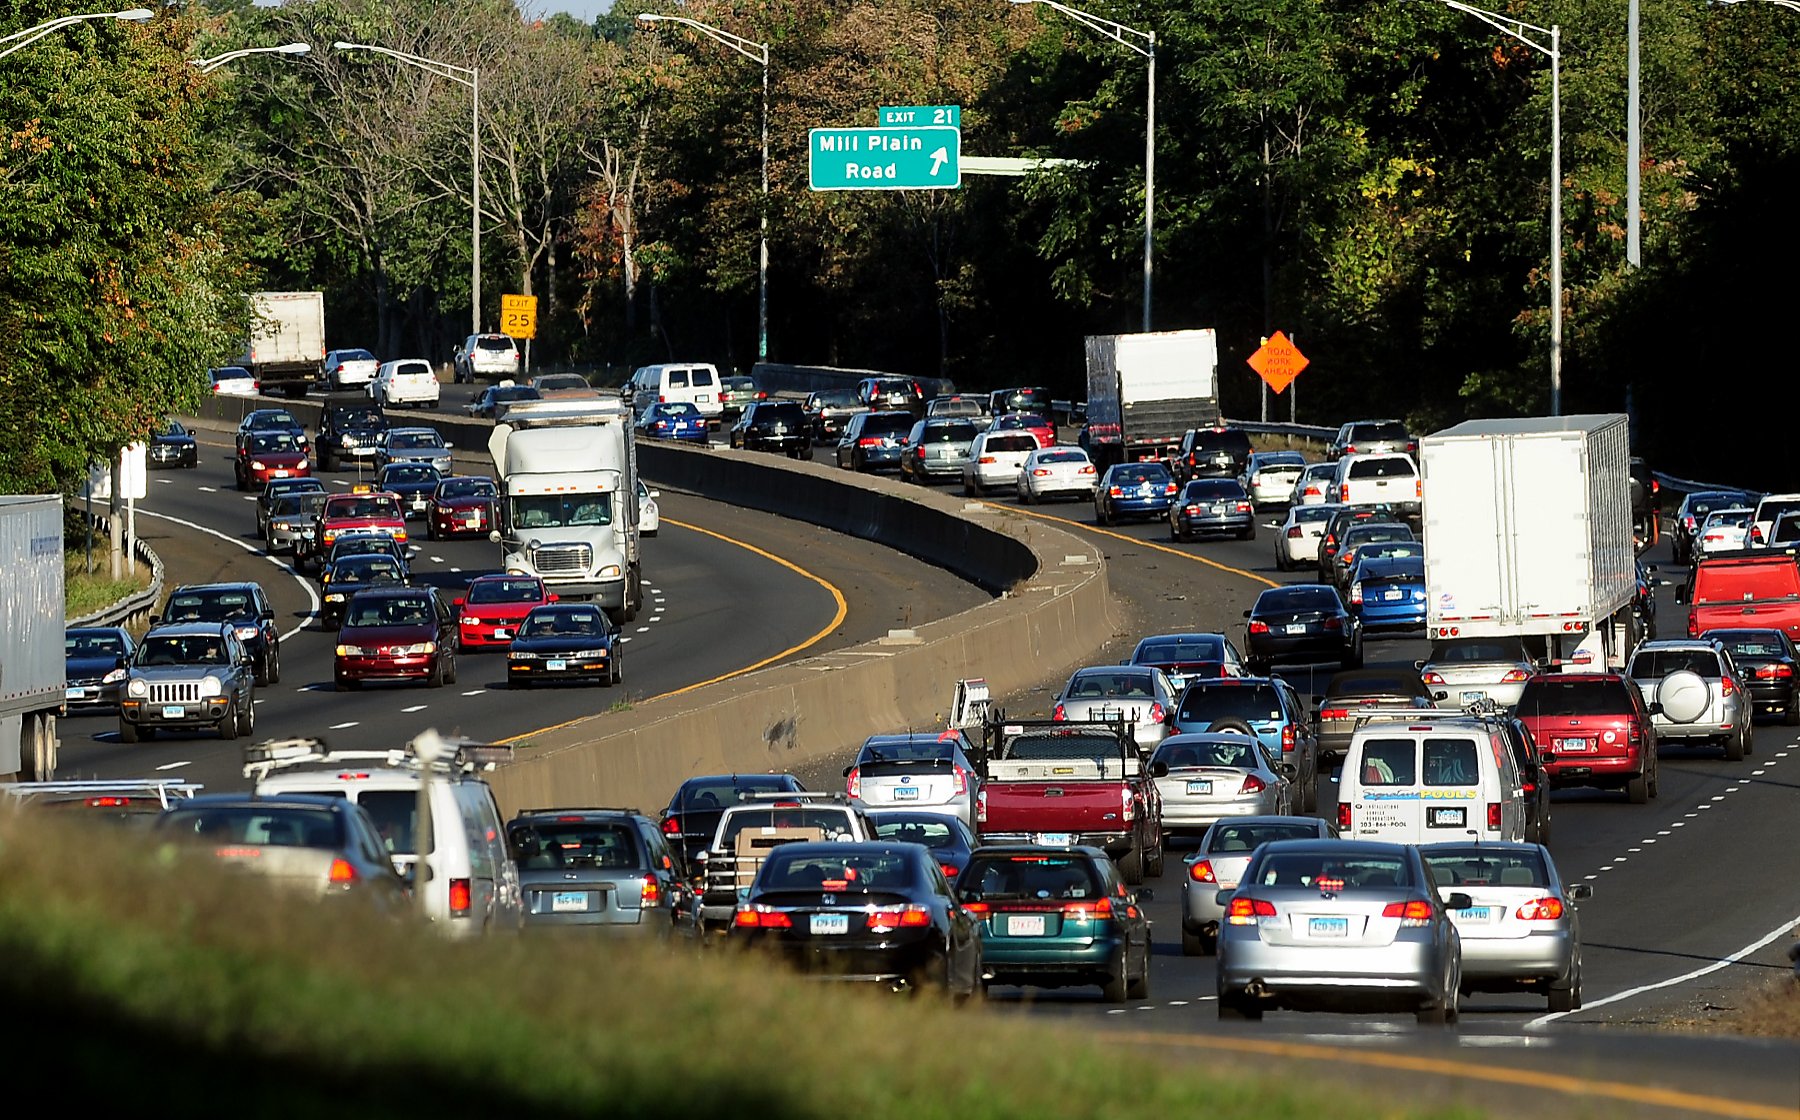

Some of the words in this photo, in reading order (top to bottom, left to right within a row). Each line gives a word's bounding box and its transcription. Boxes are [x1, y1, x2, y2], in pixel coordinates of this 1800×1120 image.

[886, 111, 915, 123] EXIT
[932, 109, 953, 124] 21
[819, 135, 858, 152] Mill
[868, 135, 922, 151] Plain
[845, 162, 897, 179] Road
[509, 299, 528, 307] EXIT
[508, 313, 529, 327] 25
[1267, 347, 1291, 356] ROAD
[1267, 357, 1291, 365] WORK
[1264, 368, 1294, 376] AHEAD
[1420, 790, 1478, 800] POOLS
